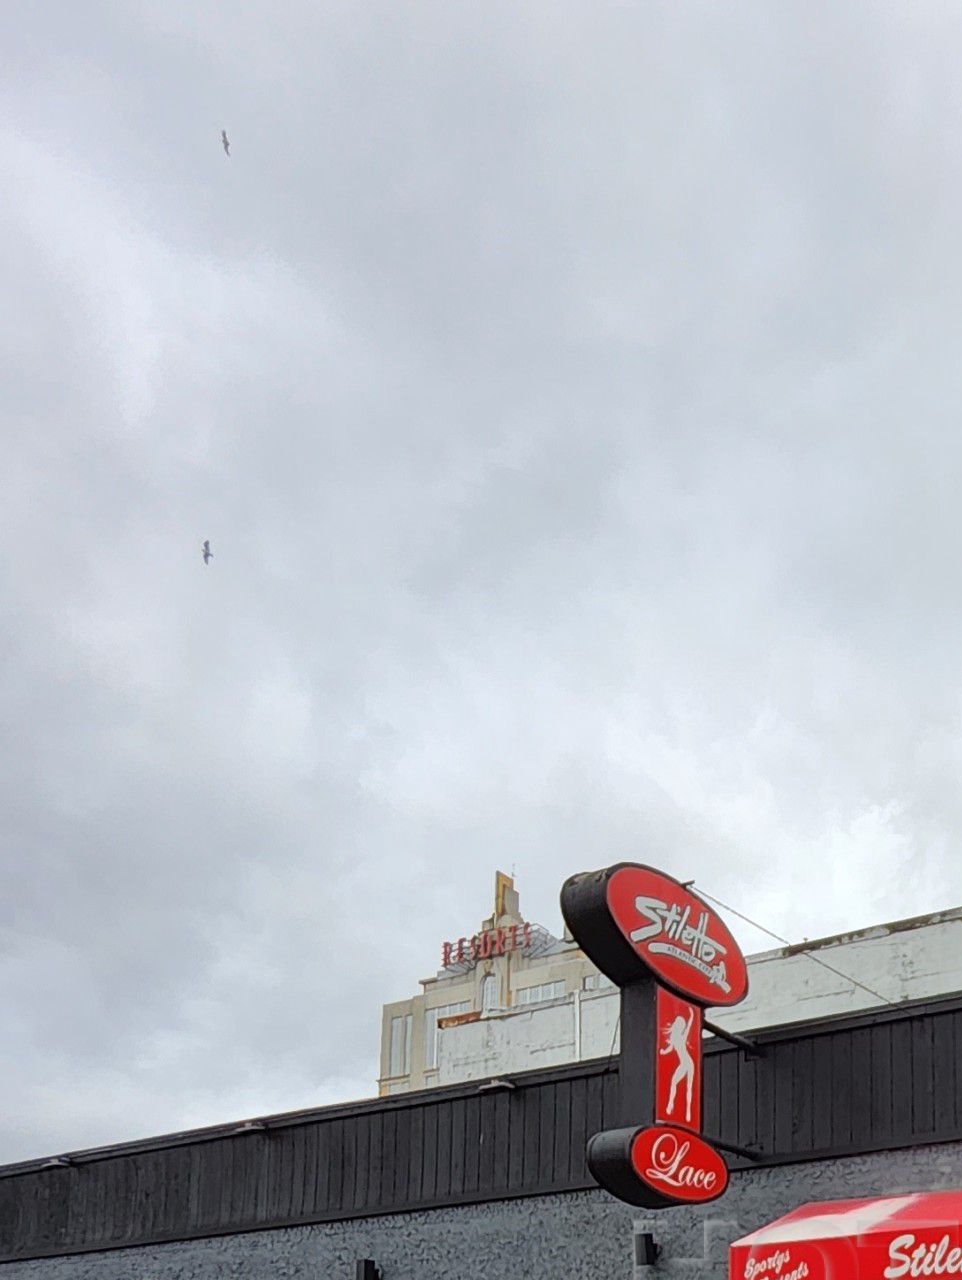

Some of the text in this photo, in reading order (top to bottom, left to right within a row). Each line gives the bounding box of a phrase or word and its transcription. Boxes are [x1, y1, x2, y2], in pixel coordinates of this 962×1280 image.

[441, 922, 532, 968] RESORTS
[631, 896, 727, 962] Stiletto
[645, 1133, 717, 1190] Lace
